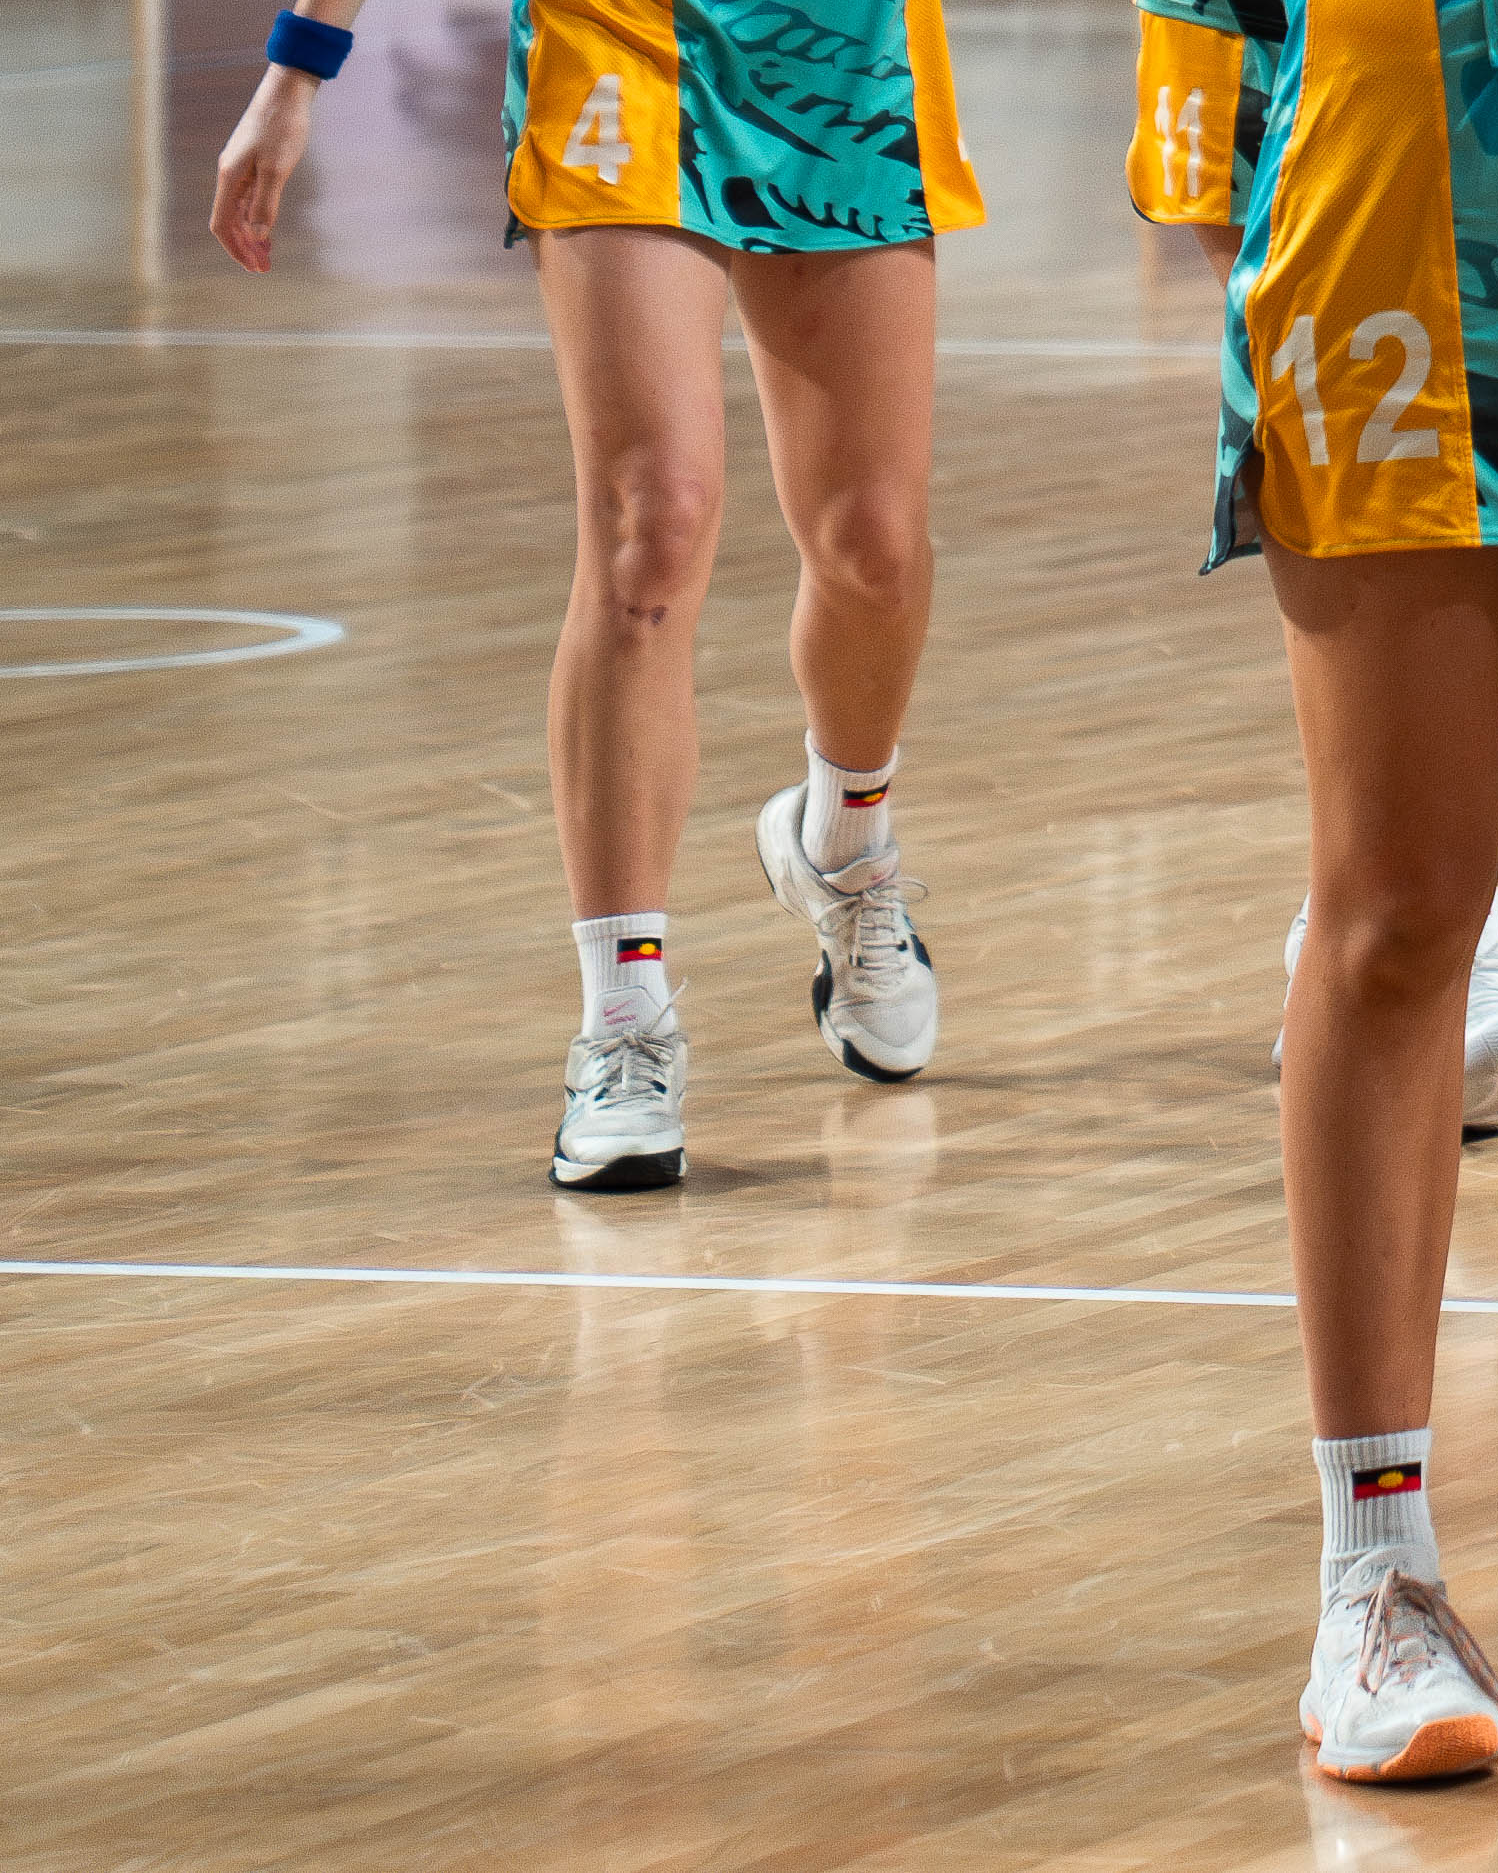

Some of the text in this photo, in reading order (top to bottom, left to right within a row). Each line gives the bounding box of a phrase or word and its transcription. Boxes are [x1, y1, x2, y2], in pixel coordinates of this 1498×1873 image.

[561, 73, 632, 185] 4
[1154, 86, 1206, 198] 11
[1268, 308, 1439, 466] 12
